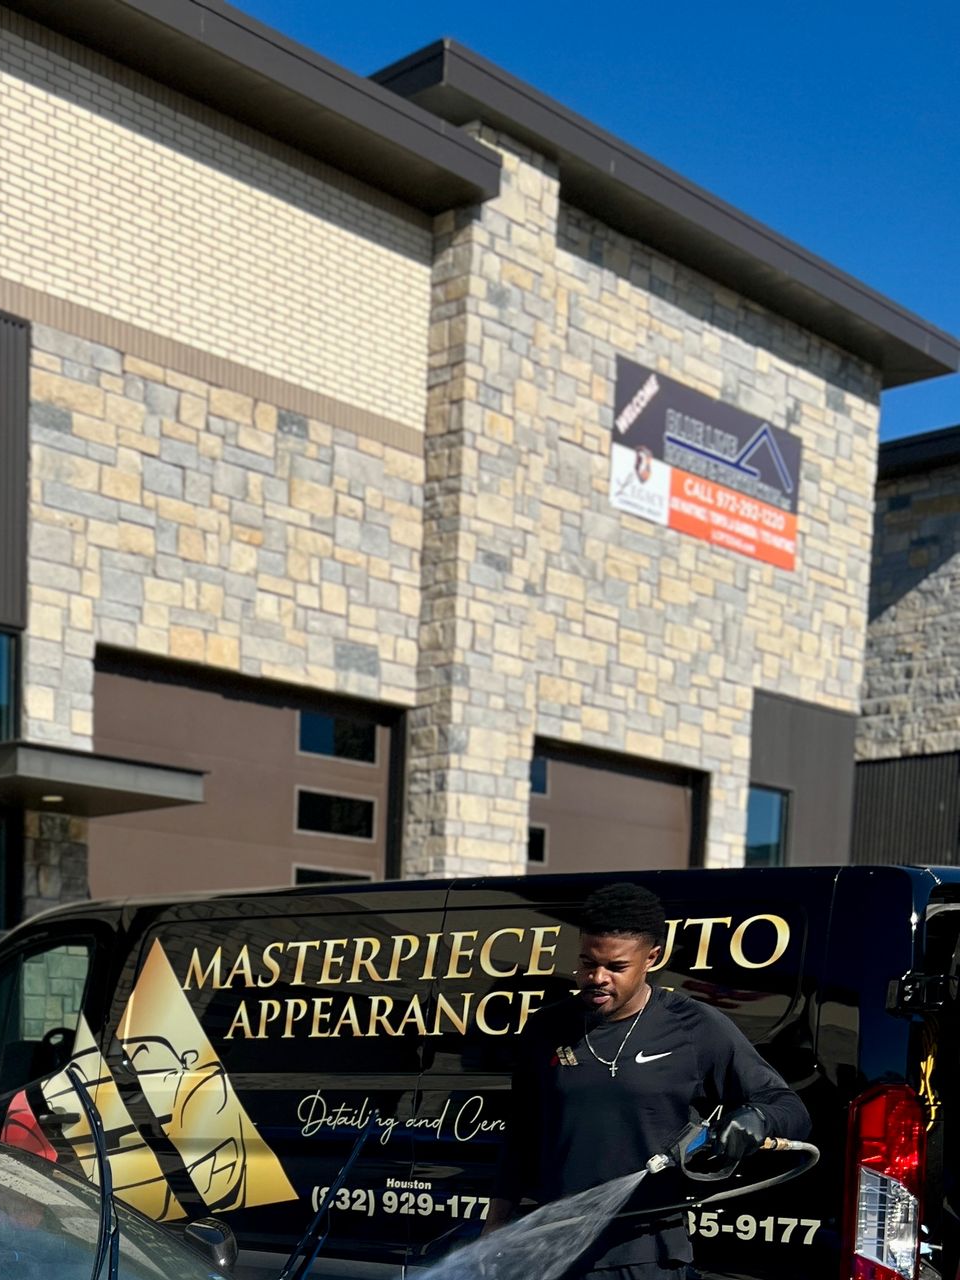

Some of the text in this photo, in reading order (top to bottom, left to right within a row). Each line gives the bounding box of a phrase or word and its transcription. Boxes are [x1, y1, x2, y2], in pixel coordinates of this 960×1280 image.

[683, 476, 713, 504] CALL
[183, 925, 562, 991] MASTERPIECE
[405, 1099, 451, 1139] and
[454, 1095, 506, 1141] Cer
[386, 1178, 432, 1190] Houston
[382, 1191, 490, 1220] 929-177
